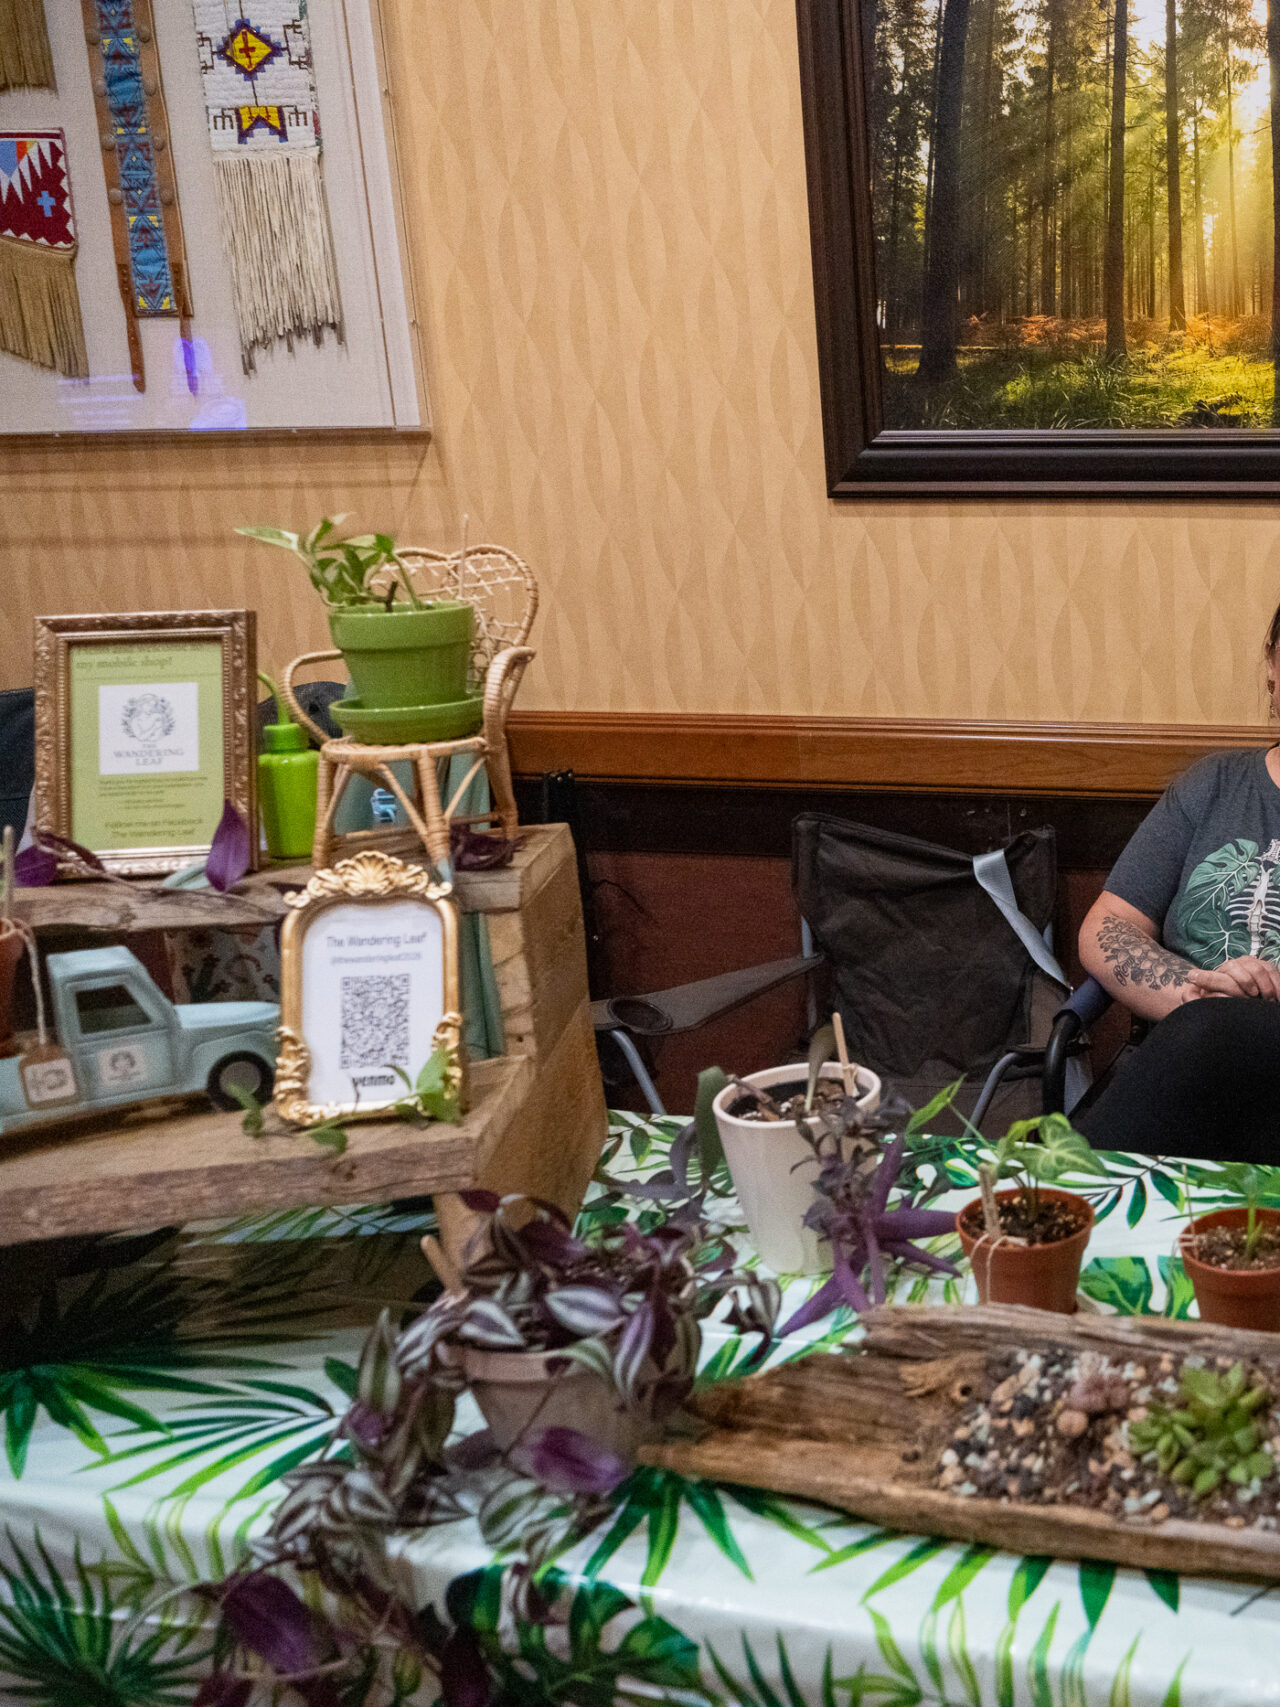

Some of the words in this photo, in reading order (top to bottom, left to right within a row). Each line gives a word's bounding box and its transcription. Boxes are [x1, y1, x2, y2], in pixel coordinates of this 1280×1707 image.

[113, 748, 184, 758] WANDERING
[135, 757, 162, 766] LEAF
[326, 936, 345, 947] The
[347, 935, 401, 948] Wandering
[403, 931, 427, 945] Leaf
